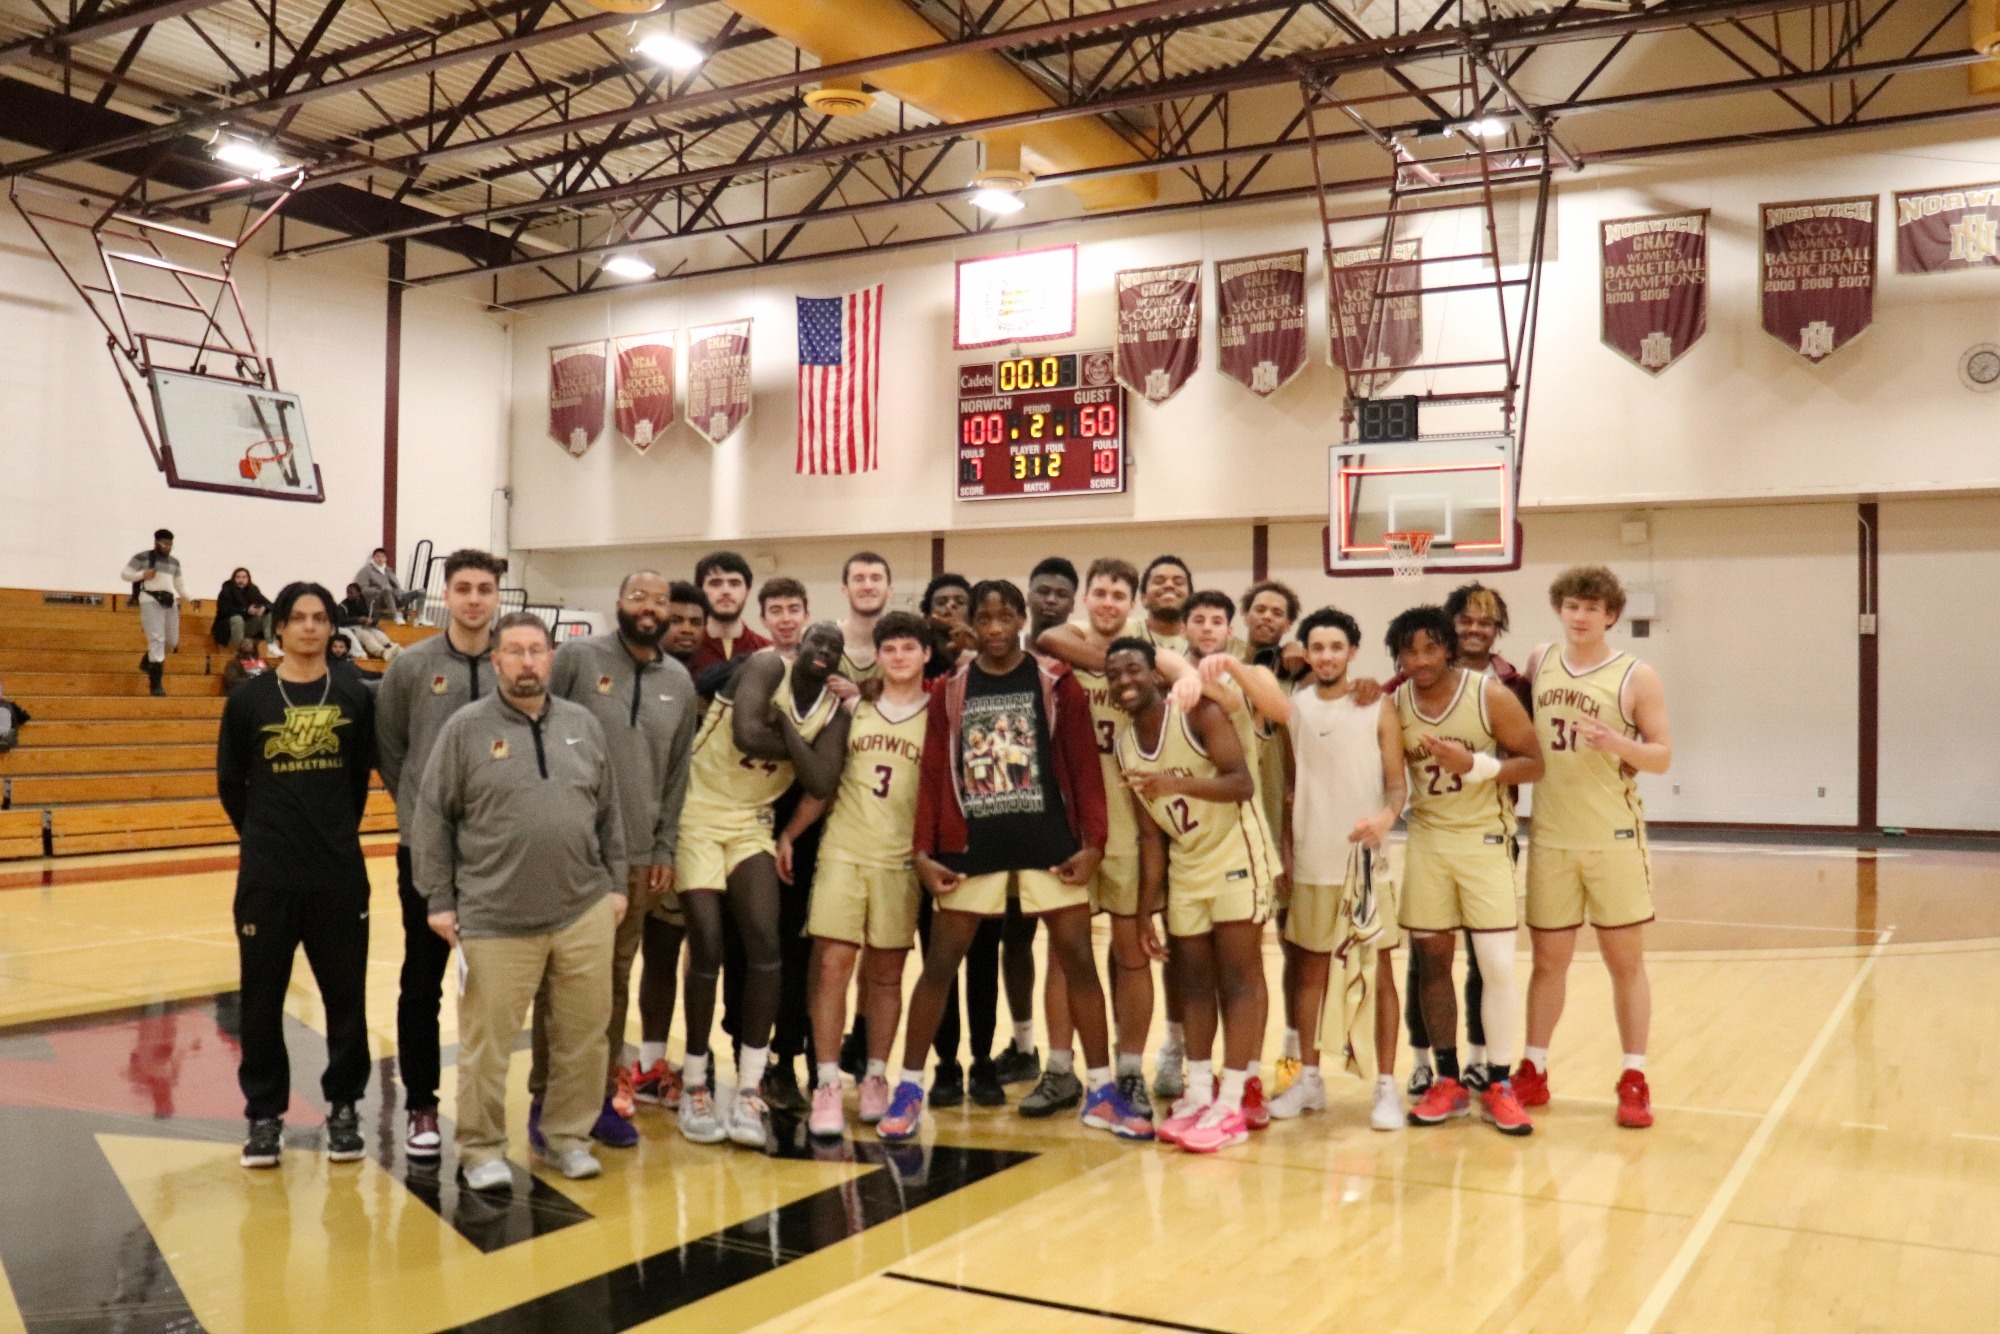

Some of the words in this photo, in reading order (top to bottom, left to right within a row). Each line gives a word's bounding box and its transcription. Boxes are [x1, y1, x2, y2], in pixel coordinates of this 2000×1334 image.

[1765, 201, 1873, 231] NORWICH
[1605, 215, 1704, 246] NORWICH
[1793, 221, 1843, 238] NCAA
[1633, 233, 1675, 251] GNAC
[1627, 249, 1682, 263] WOMEN'S
[1765, 247, 1871, 266] BASKETBALL
[1220, 254, 1303, 283] NORWICH
[1605, 257, 1704, 279] BASKETBALL
[1768, 261, 1868, 279] PARTICIPANTS
[1244, 272, 1278, 288] GNAC
[1605, 272, 1704, 292] CHAMPIONS
[1232, 294, 1291, 313] SOCCER
[1119, 316, 1197, 333] CHAMPIONS
[1221, 305, 1304, 327] CHAMPIONS
[624, 375, 665, 389] SOCCER
[961, 374, 993, 389] Cadets
[961, 398, 1013, 414] NORWICH
[1074, 389, 1112, 405] GUEST
[1023, 404, 1051, 415] PERIOD
[964, 413, 1004, 445] 100
[1080, 404, 1116, 437] 60
[1010, 444, 1040, 456] PLAYER
[1045, 443, 1065, 454] FOUL
[1092, 439, 1119, 451] FOULS
[961, 449, 985, 460] FOULS
[1094, 449, 1115, 474] 10
[970, 458, 983, 480] 7
[960, 485, 985, 497] SCORE
[1023, 482, 1050, 493] MATCH
[1090, 478, 1116, 489] SCORE
[1537, 688, 1600, 719] NORWICH
[1551, 717, 1578, 753] 31
[272, 757, 344, 774] BASKETBALL
[872, 765, 893, 799] 3
[1165, 797, 1199, 836] 12
